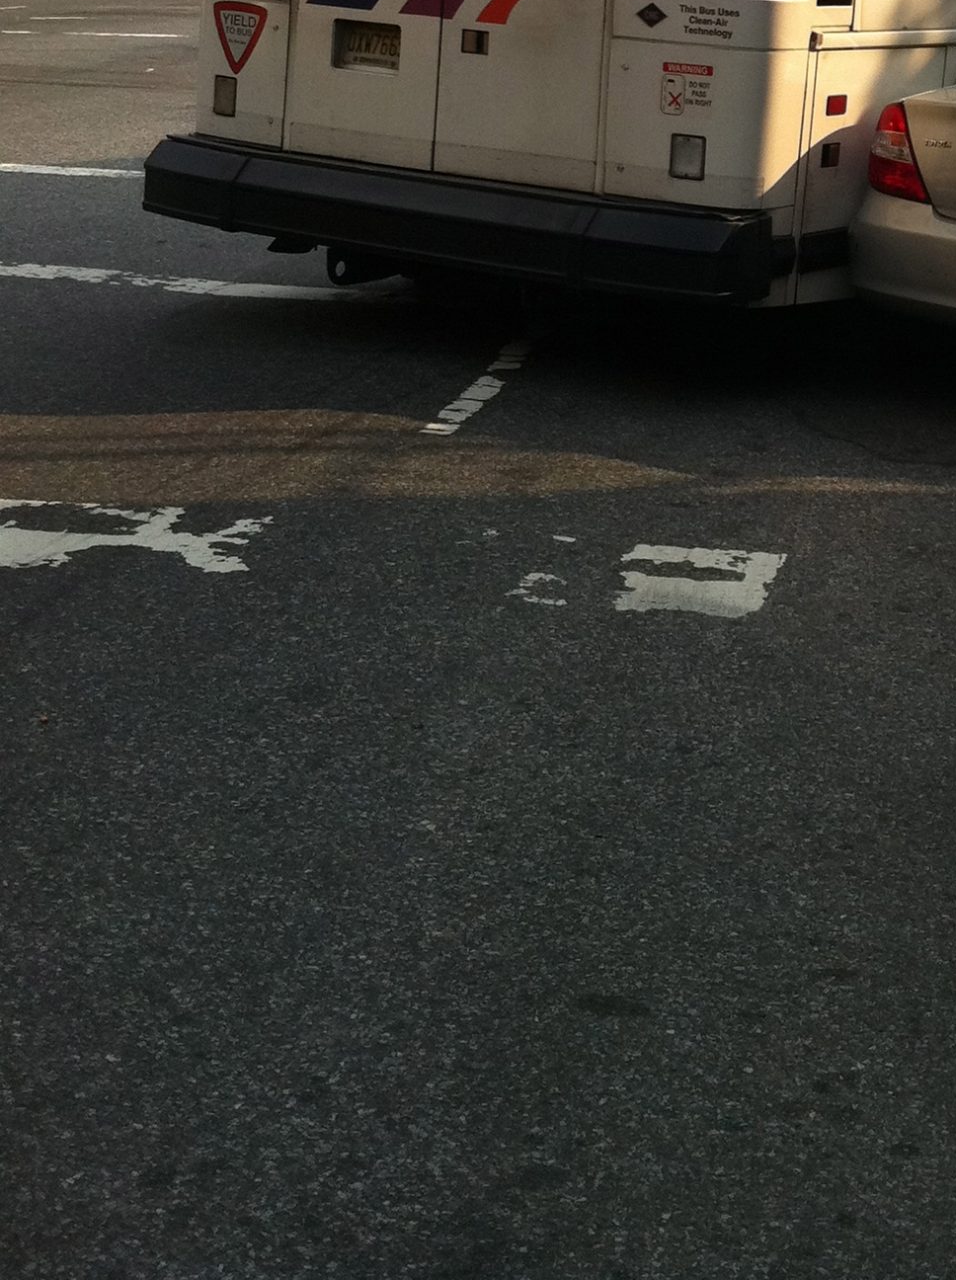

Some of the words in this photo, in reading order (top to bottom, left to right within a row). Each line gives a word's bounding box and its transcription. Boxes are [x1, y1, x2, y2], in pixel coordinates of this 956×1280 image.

[680, 4, 697, 13] This
[699, 6, 715, 15] Bus
[717, 8, 740, 17] Uses
[222, 12, 257, 28] YIELD
[689, 16, 728, 27] Clean-Air
[226, 26, 235, 34] TO
[237, 27, 252, 37] BUS
[683, 26, 733, 39] Technology
[668, 63, 708, 75] WARNING
[691, 90, 707, 98] PASS
[695, 99, 712, 107] RIGHT
